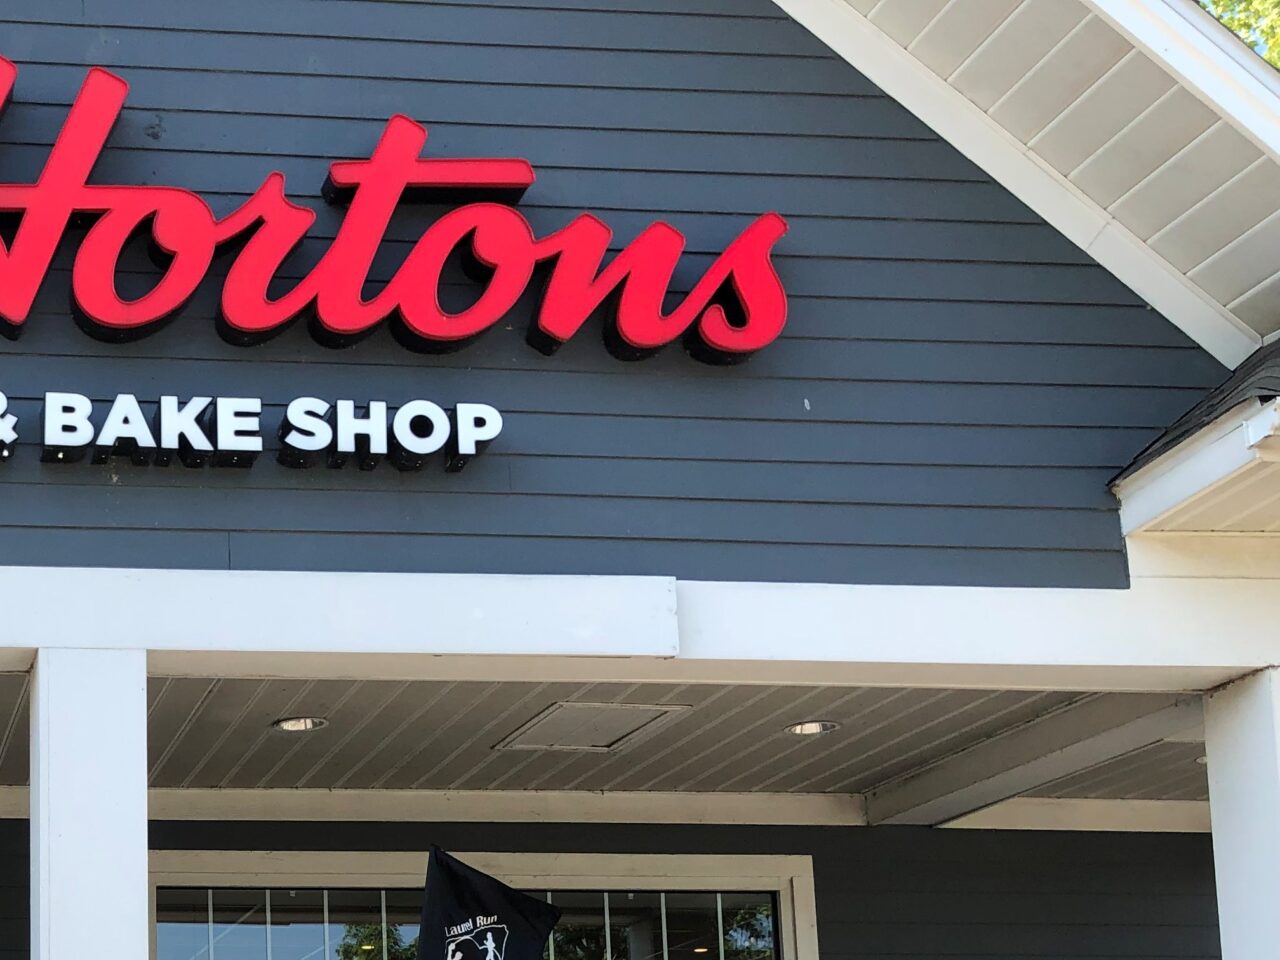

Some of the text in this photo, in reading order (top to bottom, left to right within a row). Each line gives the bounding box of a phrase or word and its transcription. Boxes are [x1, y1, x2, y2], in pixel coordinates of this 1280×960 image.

[43, 392, 263, 454] BAKE
[283, 399, 504, 457] SHOP
[444, 914, 498, 937] Laurel Run
